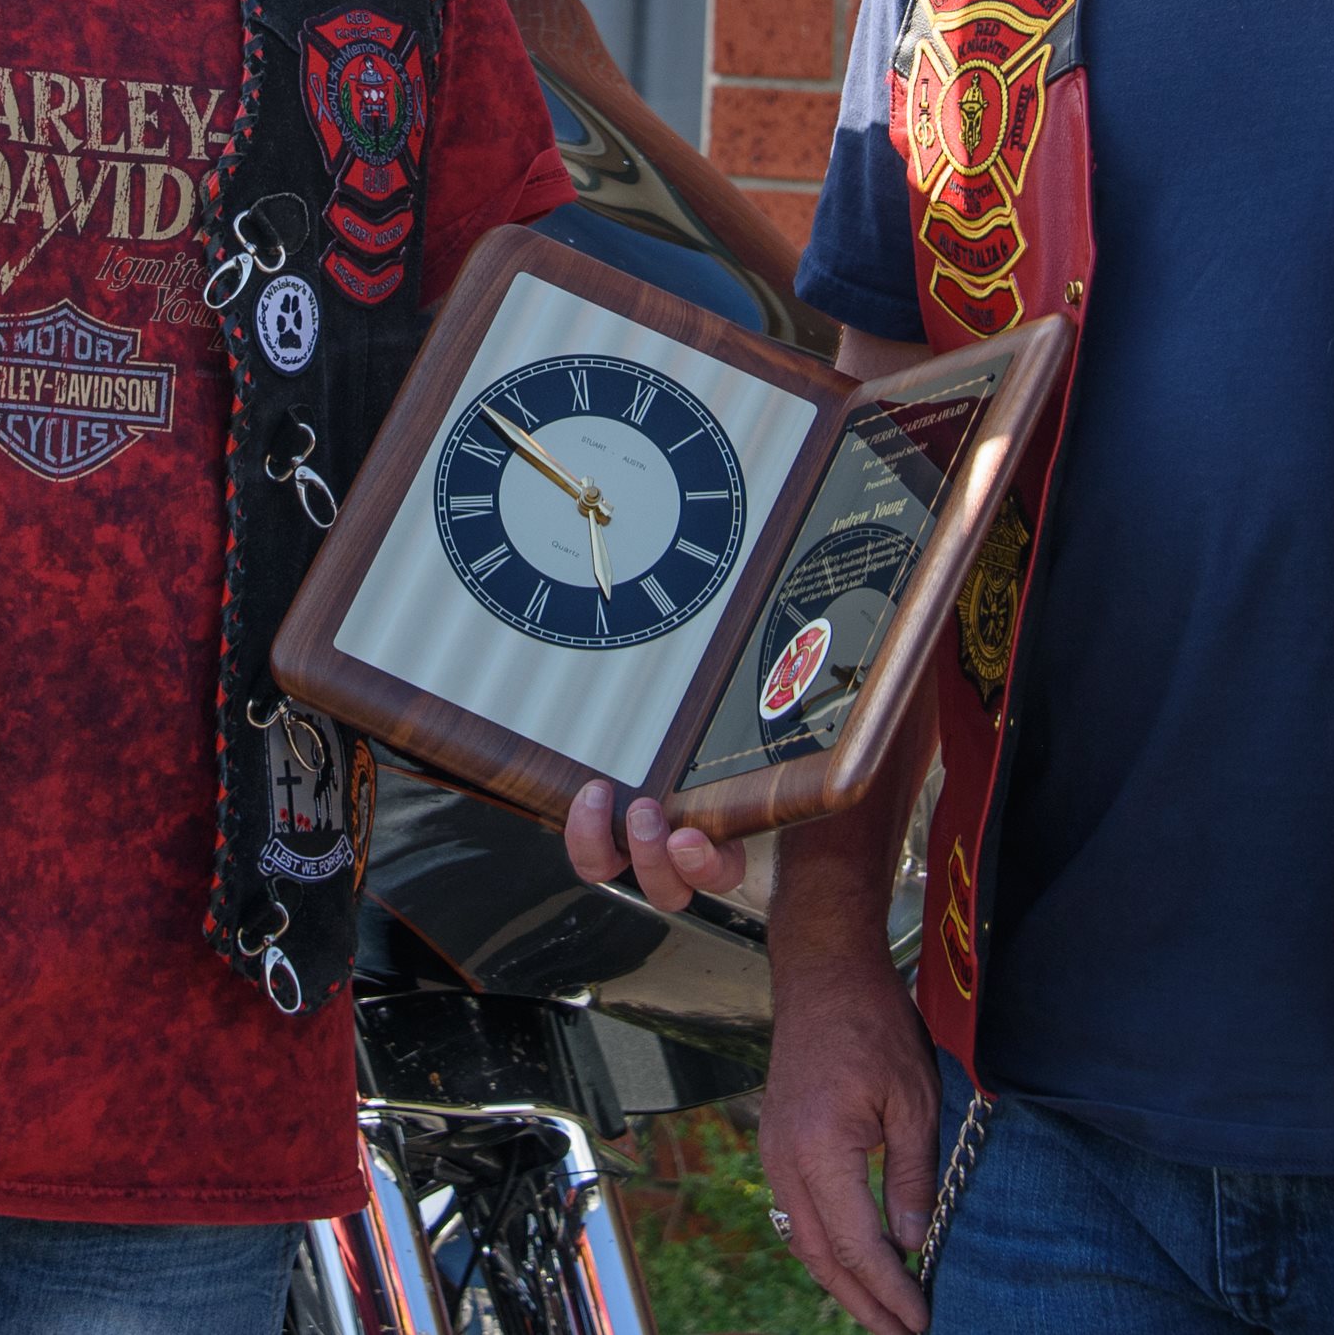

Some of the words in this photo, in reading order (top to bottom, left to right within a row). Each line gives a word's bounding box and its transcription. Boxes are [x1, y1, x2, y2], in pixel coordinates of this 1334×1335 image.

[336, 27, 391, 40] KNIGHTS
[347, 14, 371, 24] RED
[975, 22, 1000, 36] RED
[342, 42, 386, 61] Memory
[958, 37, 1010, 60] KNIGHTS
[327, 81, 344, 126] Those
[340, 126, 364, 157] Who
[364, 151, 386, 166] Have
[938, 231, 999, 267] AUSTRALIA
[264, 277, 307, 301] Whiskey's
[16, 320, 116, 363] MOTOR
[7, 414, 109, 465] CYCLES
[851, 438, 869, 453] THE
[869, 425, 900, 446] PERRY
[898, 411, 934, 435] CARTER
[932, 401, 969, 424] AWARD
[581, 435, 607, 452] STUART
[622, 455, 647, 471] AUSTIN
[826, 510, 871, 535] Andrew
[871, 497, 908, 520] Young
[551, 540, 580, 558] Quartz
[273, 846, 300, 871] LEST
[301, 860, 318, 875] WE
[319, 840, 346, 875] FORGET
